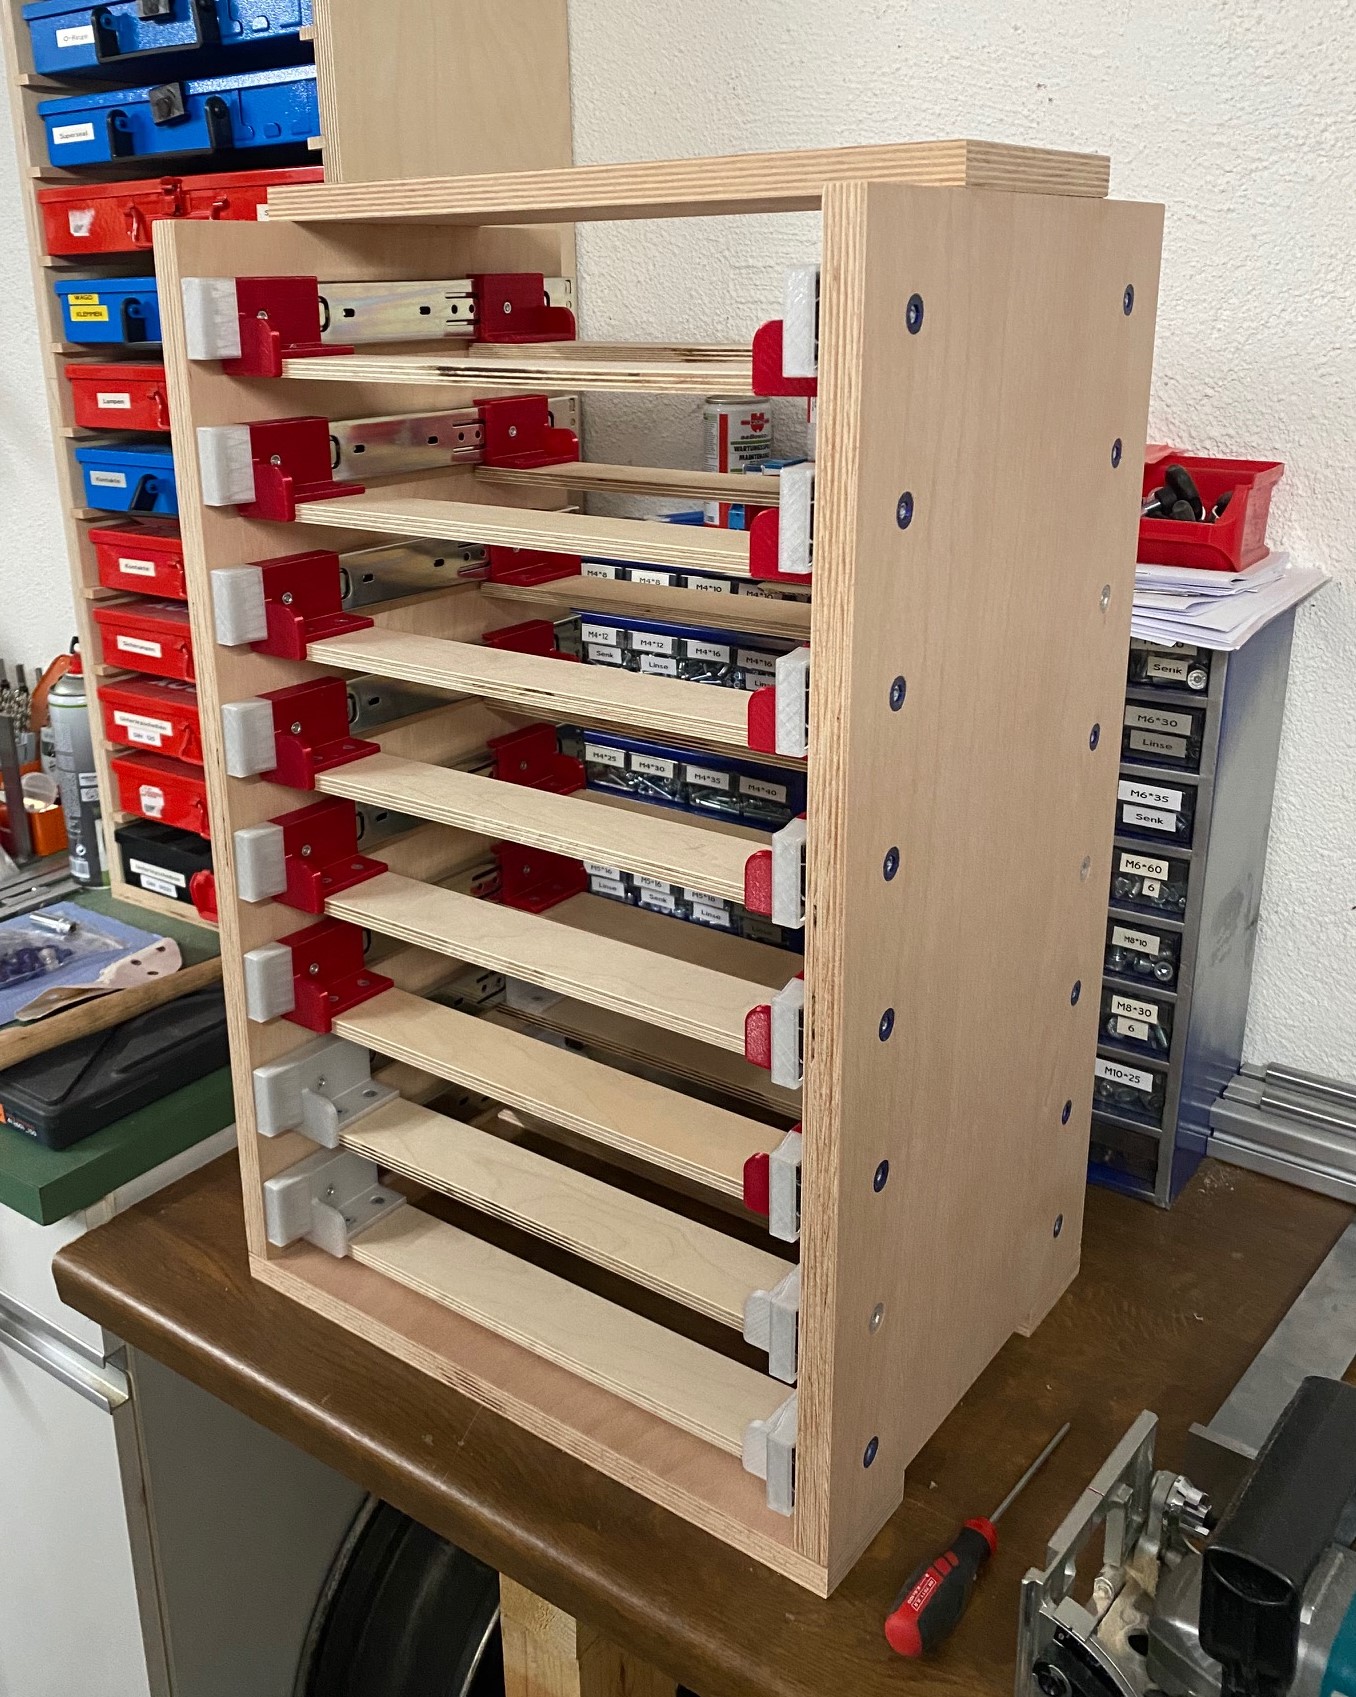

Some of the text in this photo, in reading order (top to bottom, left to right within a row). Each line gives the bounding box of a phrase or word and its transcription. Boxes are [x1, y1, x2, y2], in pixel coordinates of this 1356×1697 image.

[596, 650, 613, 659] Senk
[648, 661, 668, 670] Linse
[1153, 664, 1181, 675] Senk
[1141, 738, 1172, 750] Linse
[1136, 813, 1164, 825] Senk
[599, 882, 617, 891] Linse
[1148, 883, 1155, 892] 6
[649, 894, 667, 904] Senk
[701, 909, 721, 920] Linse
[1128, 1024, 1135, 1033] 6
